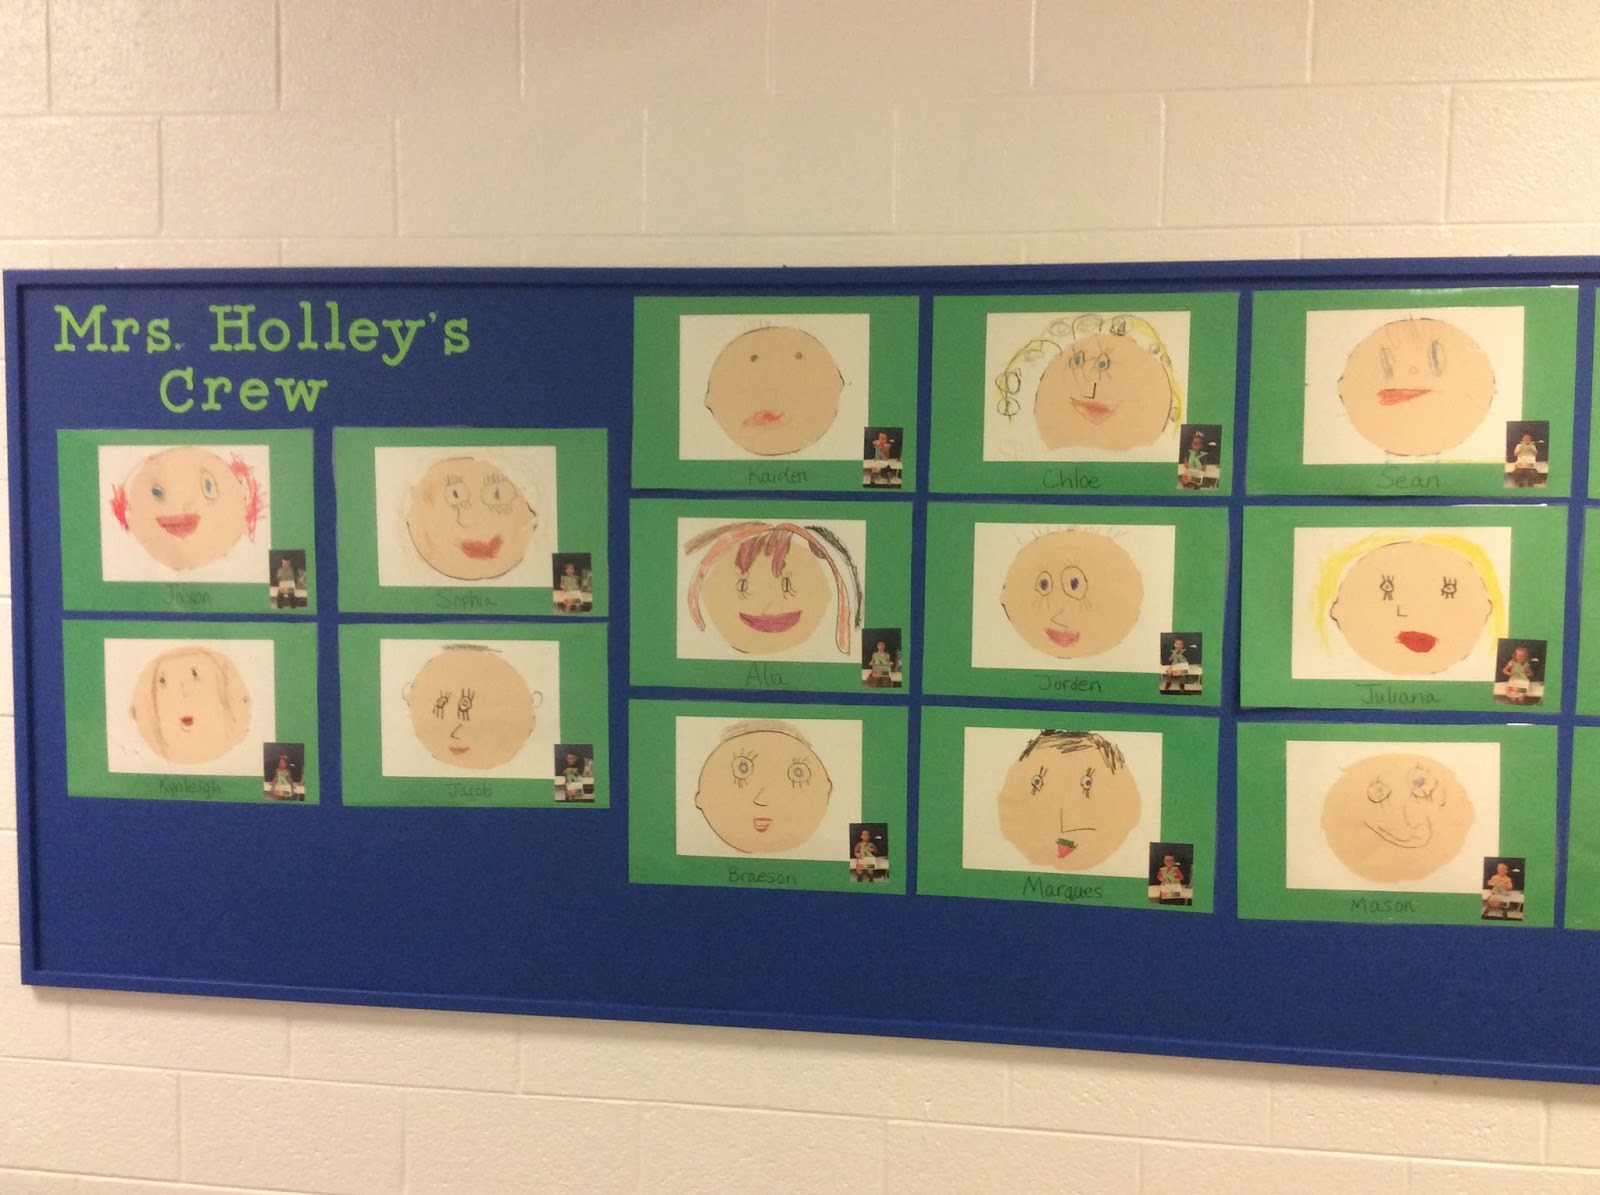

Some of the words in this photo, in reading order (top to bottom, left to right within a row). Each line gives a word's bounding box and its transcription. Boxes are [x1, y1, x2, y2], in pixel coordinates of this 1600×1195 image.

[54, 304, 184, 353] Mrs.
[208, 301, 470, 366] Holley's
[159, 367, 328, 413] Crew
[1042, 467, 1102, 489] Chloe
[1376, 465, 1440, 489] Sean
[745, 662, 788, 687] Alia
[1033, 674, 1102, 692] Jorden
[1355, 683, 1441, 704] Juliana
[445, 782, 493, 798] Jacob
[728, 866, 798, 885] Braeson
[1022, 876, 1104, 901] Marques
[1350, 897, 1415, 914] Mason
